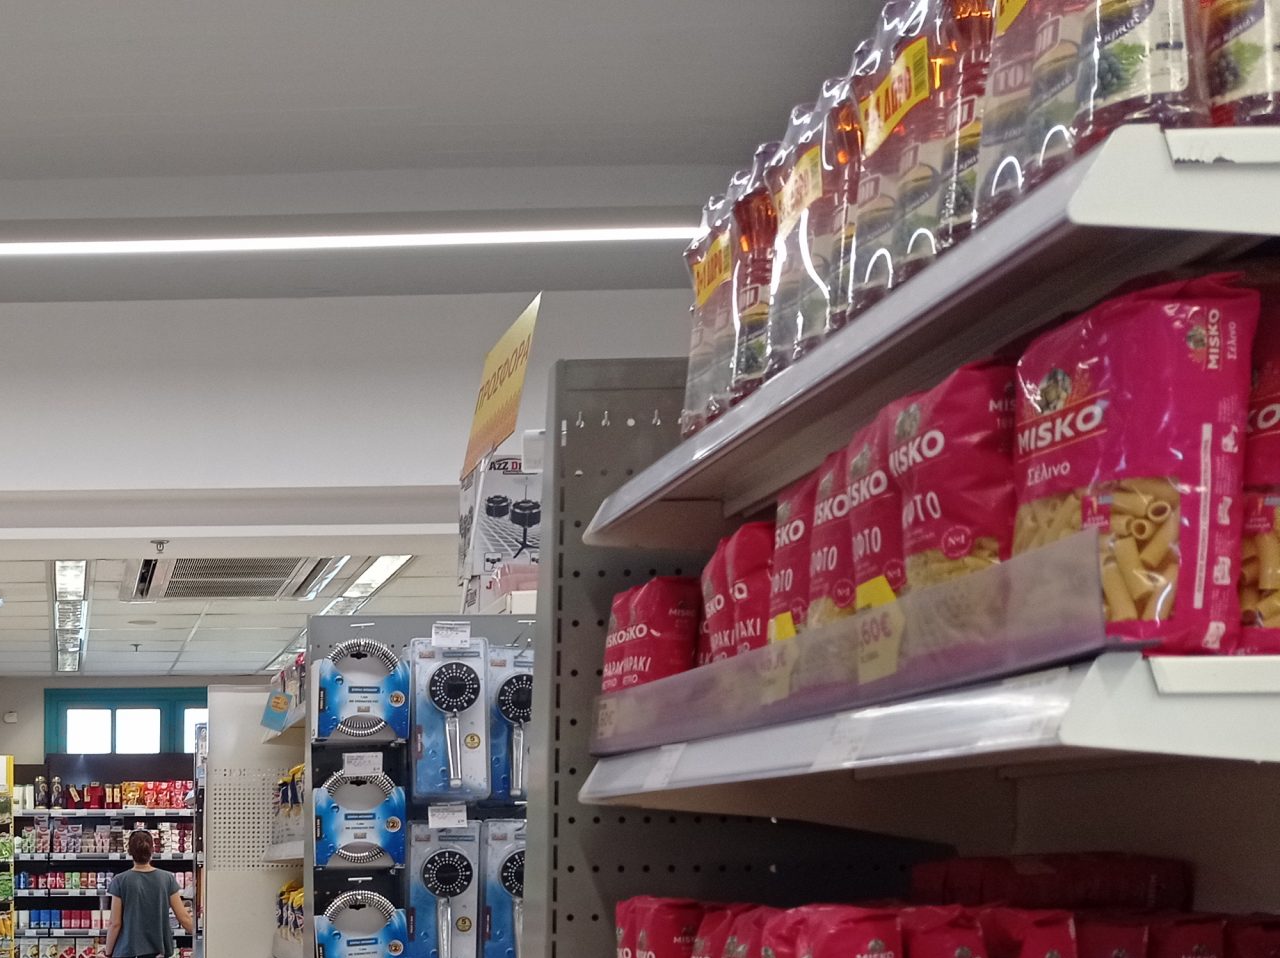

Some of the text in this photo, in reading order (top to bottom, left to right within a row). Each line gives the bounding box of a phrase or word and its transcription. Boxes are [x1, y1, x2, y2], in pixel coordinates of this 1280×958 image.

[1208, 308, 1221, 370] MISKO
[1017, 404, 1104, 455] MISKO
[1027, 461, 1071, 487] Σέλινο
